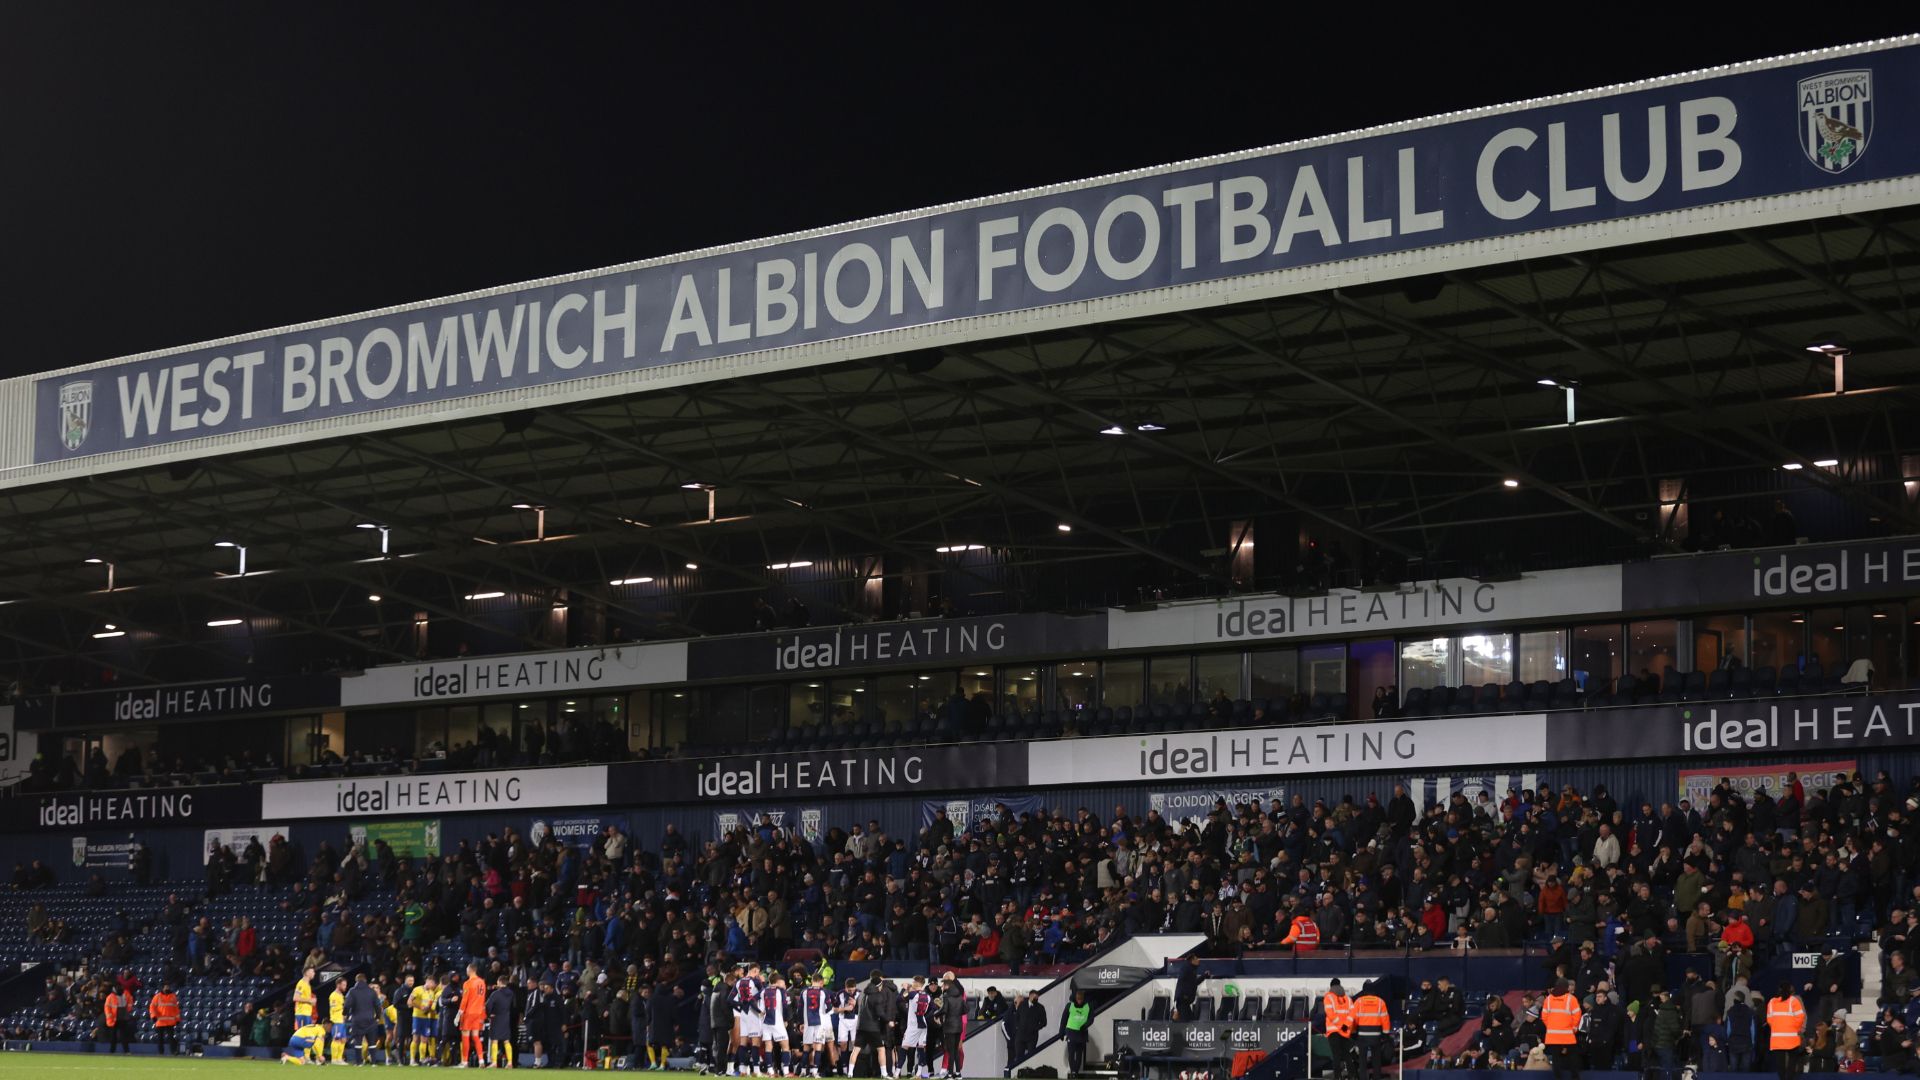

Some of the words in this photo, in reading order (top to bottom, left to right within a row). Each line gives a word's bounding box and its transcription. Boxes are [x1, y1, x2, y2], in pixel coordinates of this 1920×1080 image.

[1803, 83, 1867, 107] ALBION
[118, 350, 265, 439] WEST
[282, 284, 638, 413] BROMWICH
[660, 229, 944, 352] ALBION
[978, 147, 1444, 300] FOOTBALL
[1476, 96, 1742, 220] CLUB
[1753, 549, 1848, 596] ideal
[1217, 598, 1294, 636] ideal
[1308, 584, 1496, 627] HEATING
[776, 633, 840, 670] ideal
[851, 624, 1005, 660] HEATING
[414, 666, 466, 697] ideal
[476, 656, 603, 689] HEATING
[115, 690, 160, 720] ideal
[166, 684, 272, 714] HEATING
[1683, 706, 1778, 751] ideal
[1795, 703, 1920, 741] HEAT
[1140, 736, 1217, 776] ideal
[1231, 730, 1415, 767] HEATING
[698, 760, 761, 797] ideal
[771, 757, 923, 789] HEATING
[1720, 775, 1774, 792] ROUD
[1780, 772, 1848, 789] BGGIE
[40, 796, 83, 826] ideal
[90, 795, 192, 821] HEATING
[337, 780, 389, 813] ideal
[398, 778, 521, 806] HEATING
[1168, 794, 1215, 807] LONDON
[552, 825, 585, 836] WOMEN
[587, 824, 599, 835] FC
[1098, 967, 1120, 979] ideal
[1794, 956, 1810, 964] V10
[1142, 1027, 1170, 1041] ideal
[1185, 1027, 1215, 1041] ideal
[1231, 1027, 1260, 1041] ideal
[1277, 1027, 1307, 1041] ide
